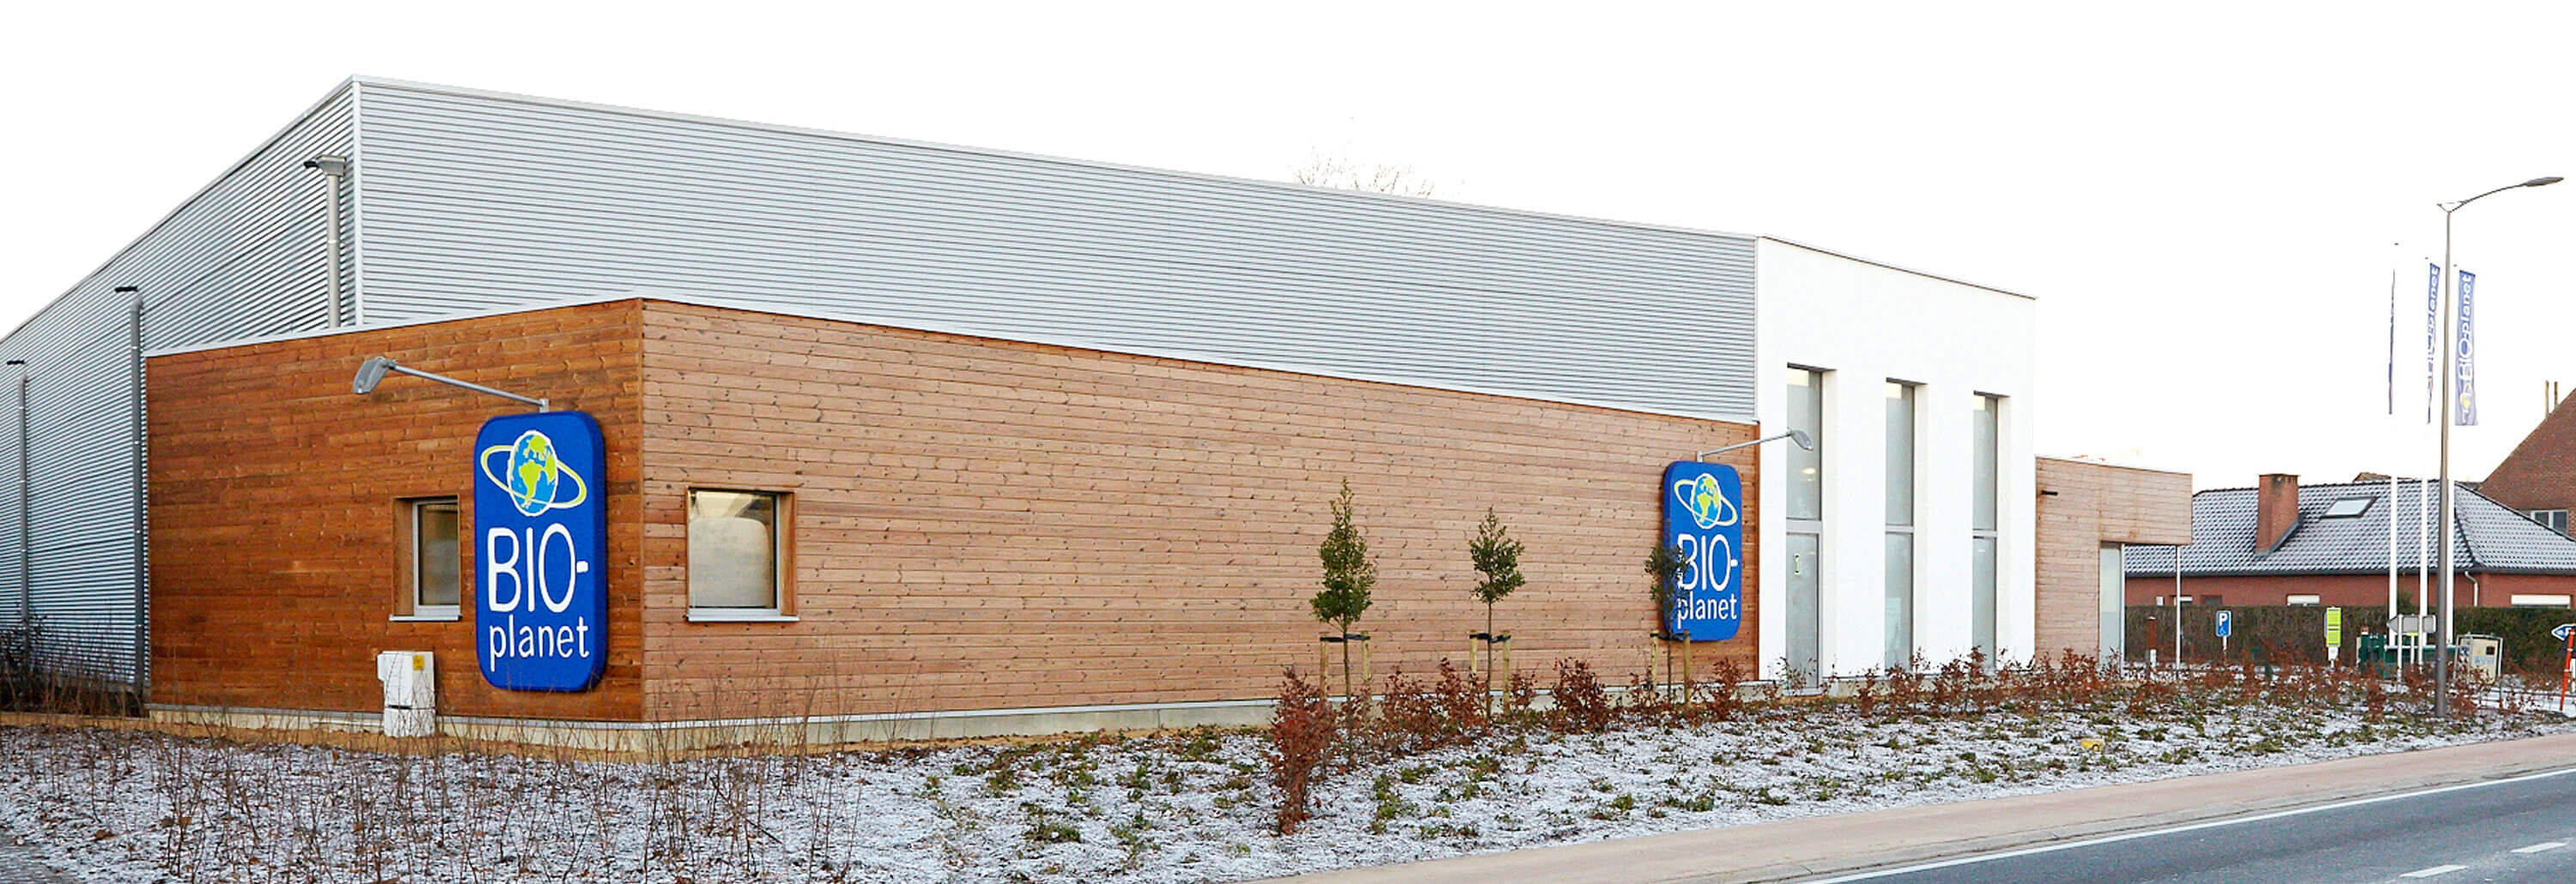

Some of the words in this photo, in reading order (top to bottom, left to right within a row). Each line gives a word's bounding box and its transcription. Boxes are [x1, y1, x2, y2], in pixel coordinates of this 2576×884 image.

[2458, 275, 2473, 380] BIO-planet
[488, 523, 589, 613] BIO-
[1677, 533, 1739, 591] BIO-
[1677, 590, 1738, 630] planet
[2219, 613, 2228, 627] P
[489, 614, 590, 672] planet
